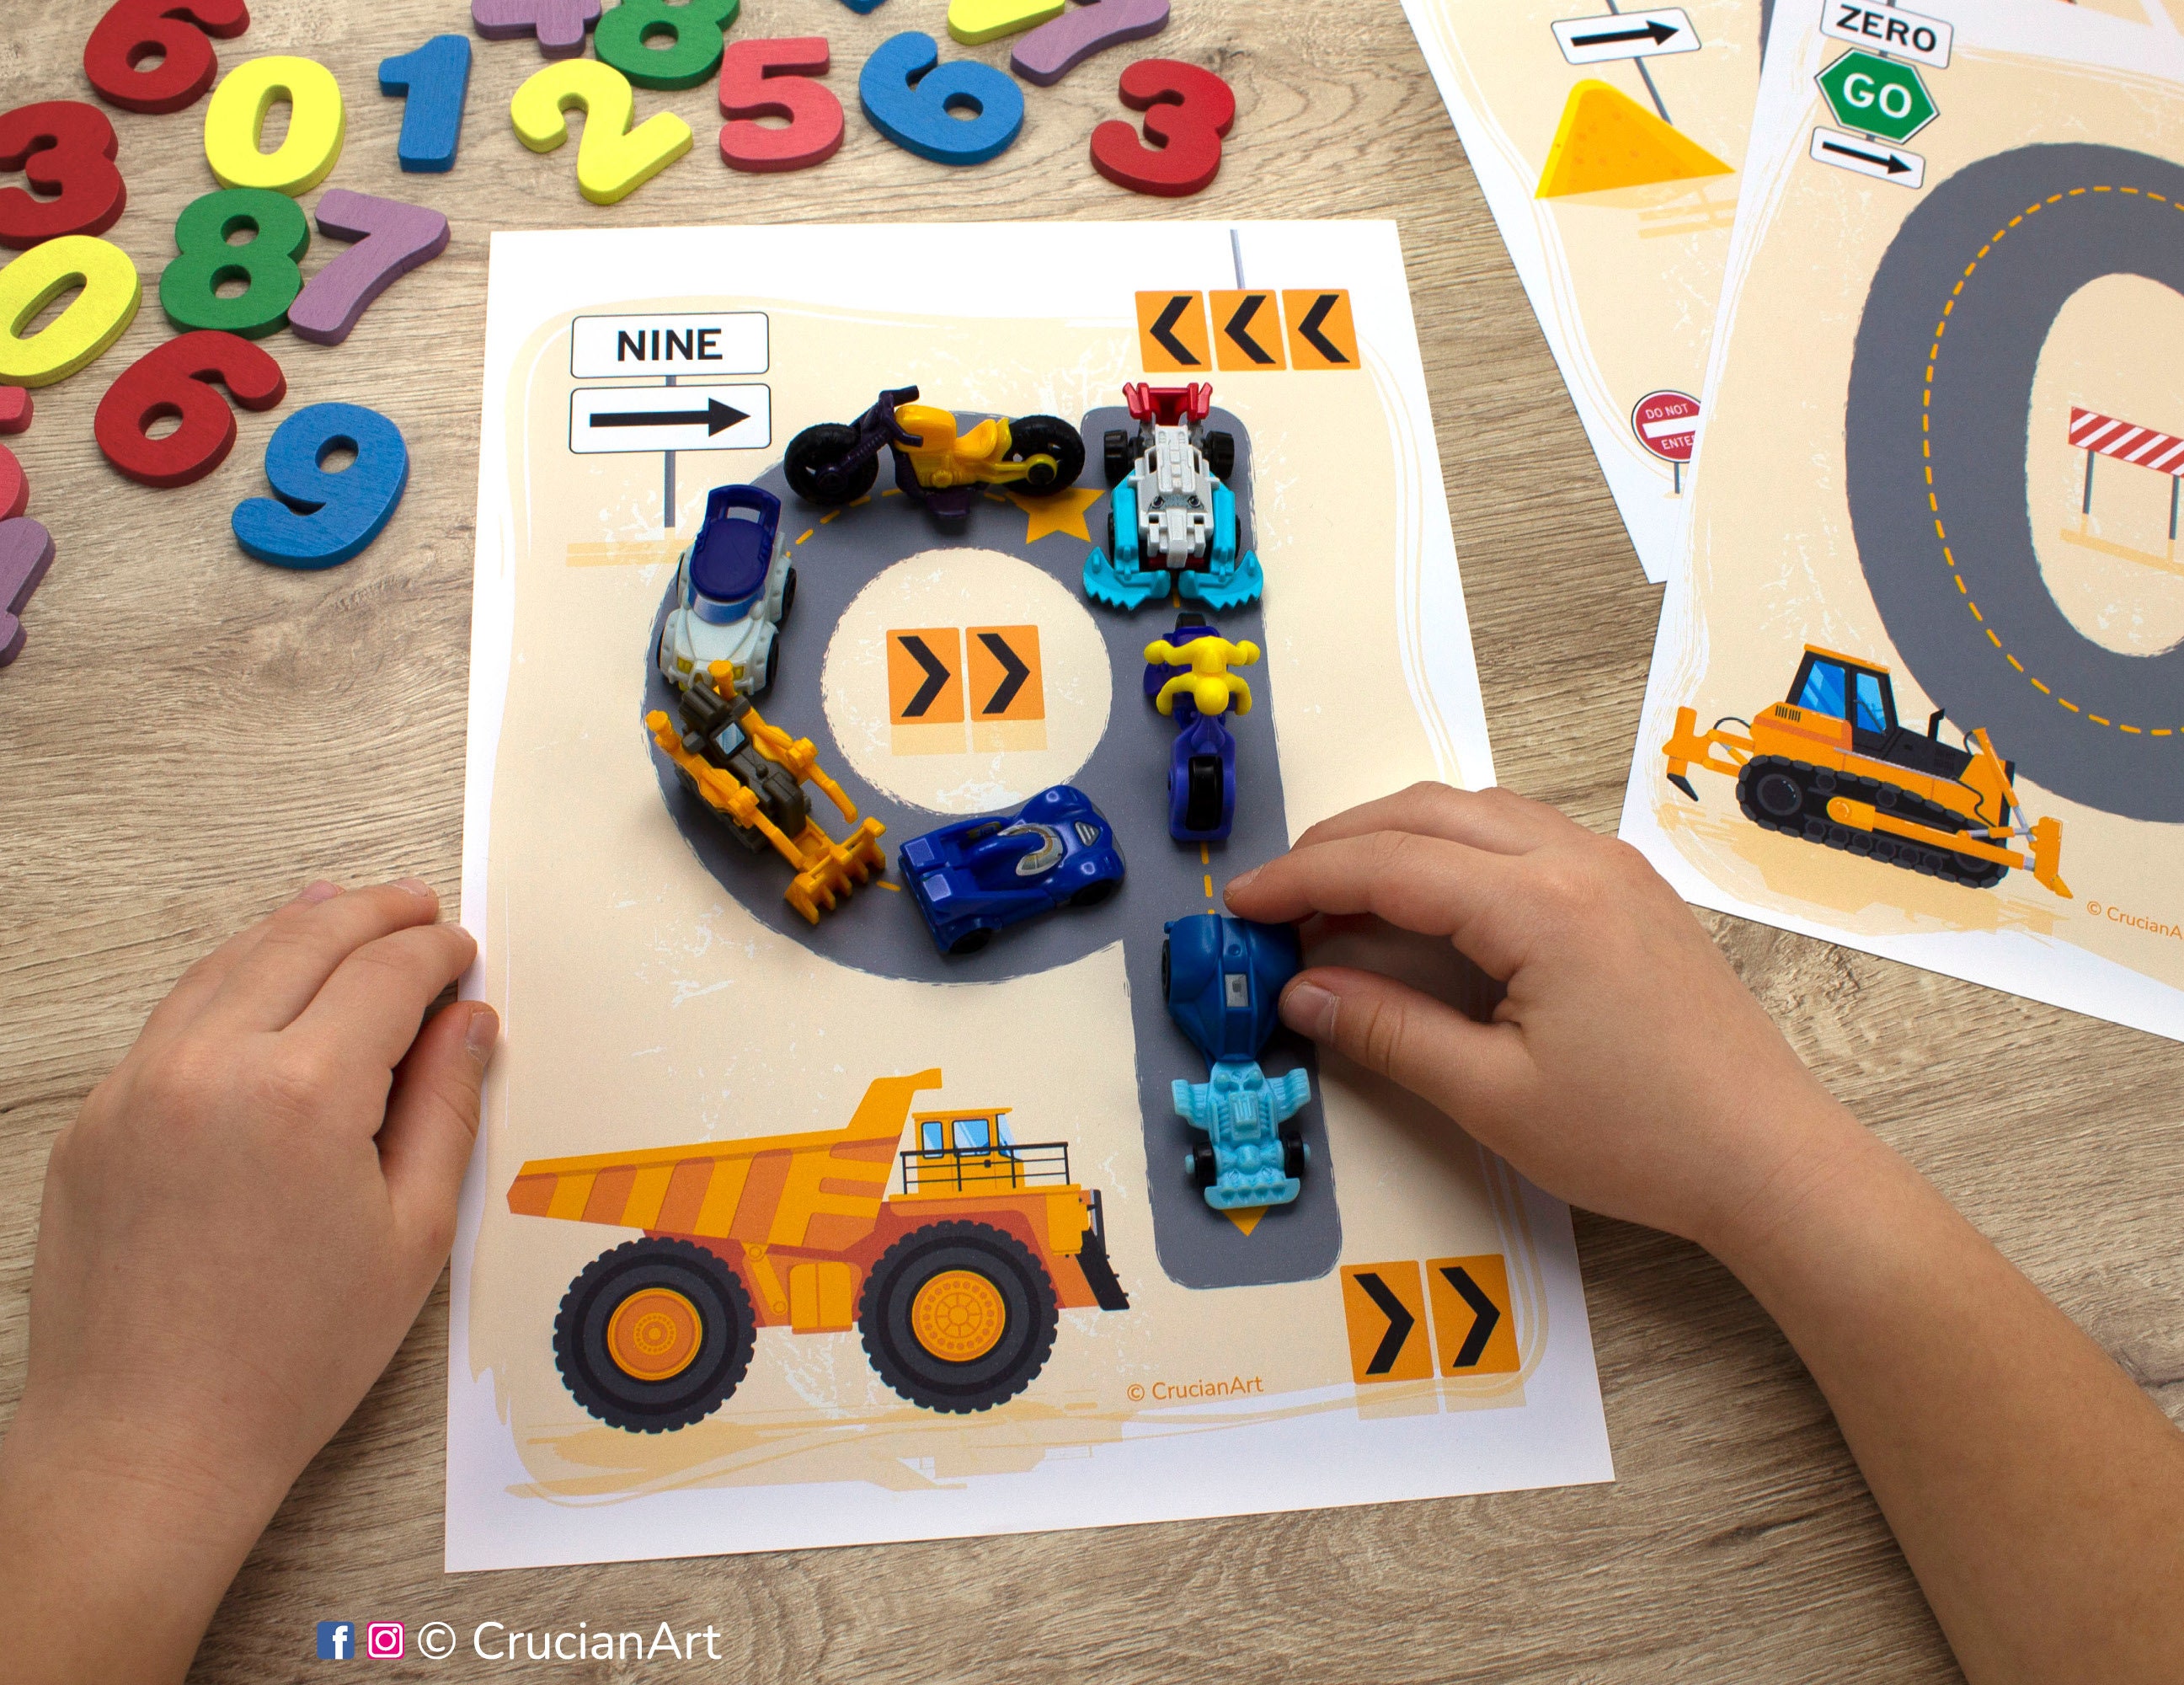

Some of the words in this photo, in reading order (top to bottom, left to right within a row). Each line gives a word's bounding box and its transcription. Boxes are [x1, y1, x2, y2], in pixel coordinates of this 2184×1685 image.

[1836, 3, 1937, 53] ZERO
[1843, 72, 1913, 120] GO
[378, 35, 473, 173] 1
[510, 58, 694, 206] 2
[718, 36, 845, 173] 5
[1090, 58, 1236, 197] 3
[160, 188, 310, 340] 8
[288, 188, 451, 346] 7
[94, 329, 287, 489] 6
[617, 328, 724, 362] NINE
[1645, 407, 1663, 420] DO
[1664, 403, 1689, 416] NOT
[232, 402, 410, 570] 9
[2107, 906, 2184, 940] CrucianA
[1151, 1375, 1264, 1400] CrucianArt
